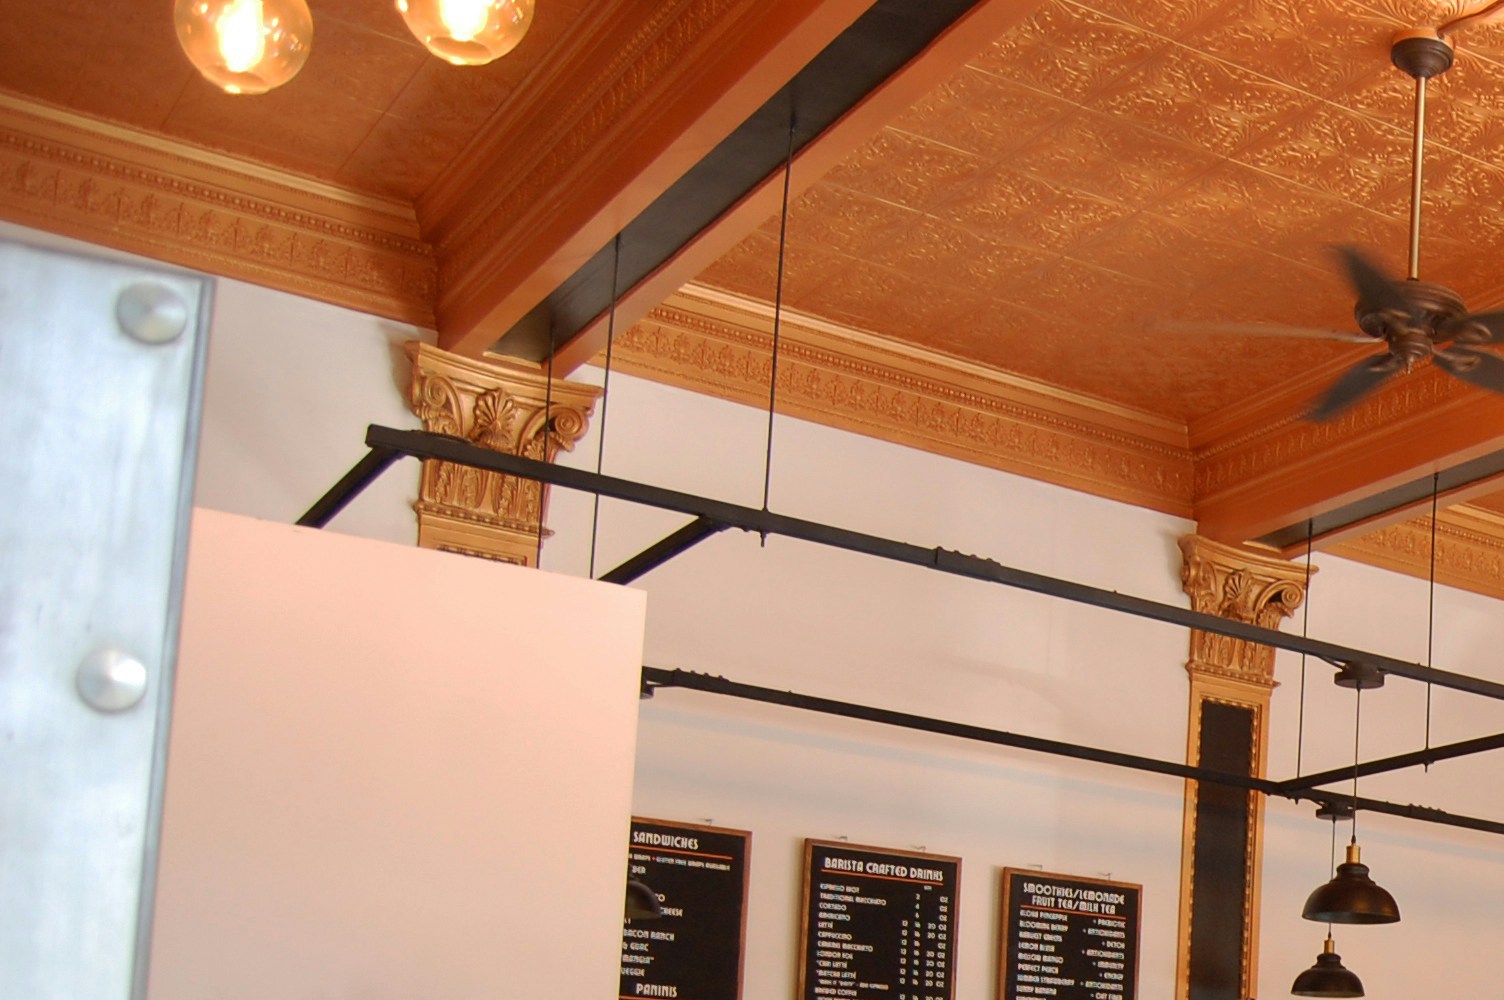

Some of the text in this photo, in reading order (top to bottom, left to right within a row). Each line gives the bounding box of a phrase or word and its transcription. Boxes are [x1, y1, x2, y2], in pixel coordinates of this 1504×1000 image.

[634, 831, 699, 850] SANDWICHES
[824, 857, 943, 881] BARISTA CRAFTED DRINKS
[1024, 883, 1125, 905] SMOOTHIES/LEMONADE
[1032, 895, 1115, 914] FRUIT TEA/MILK TEA
[636, 983, 678, 998] PANINIS
